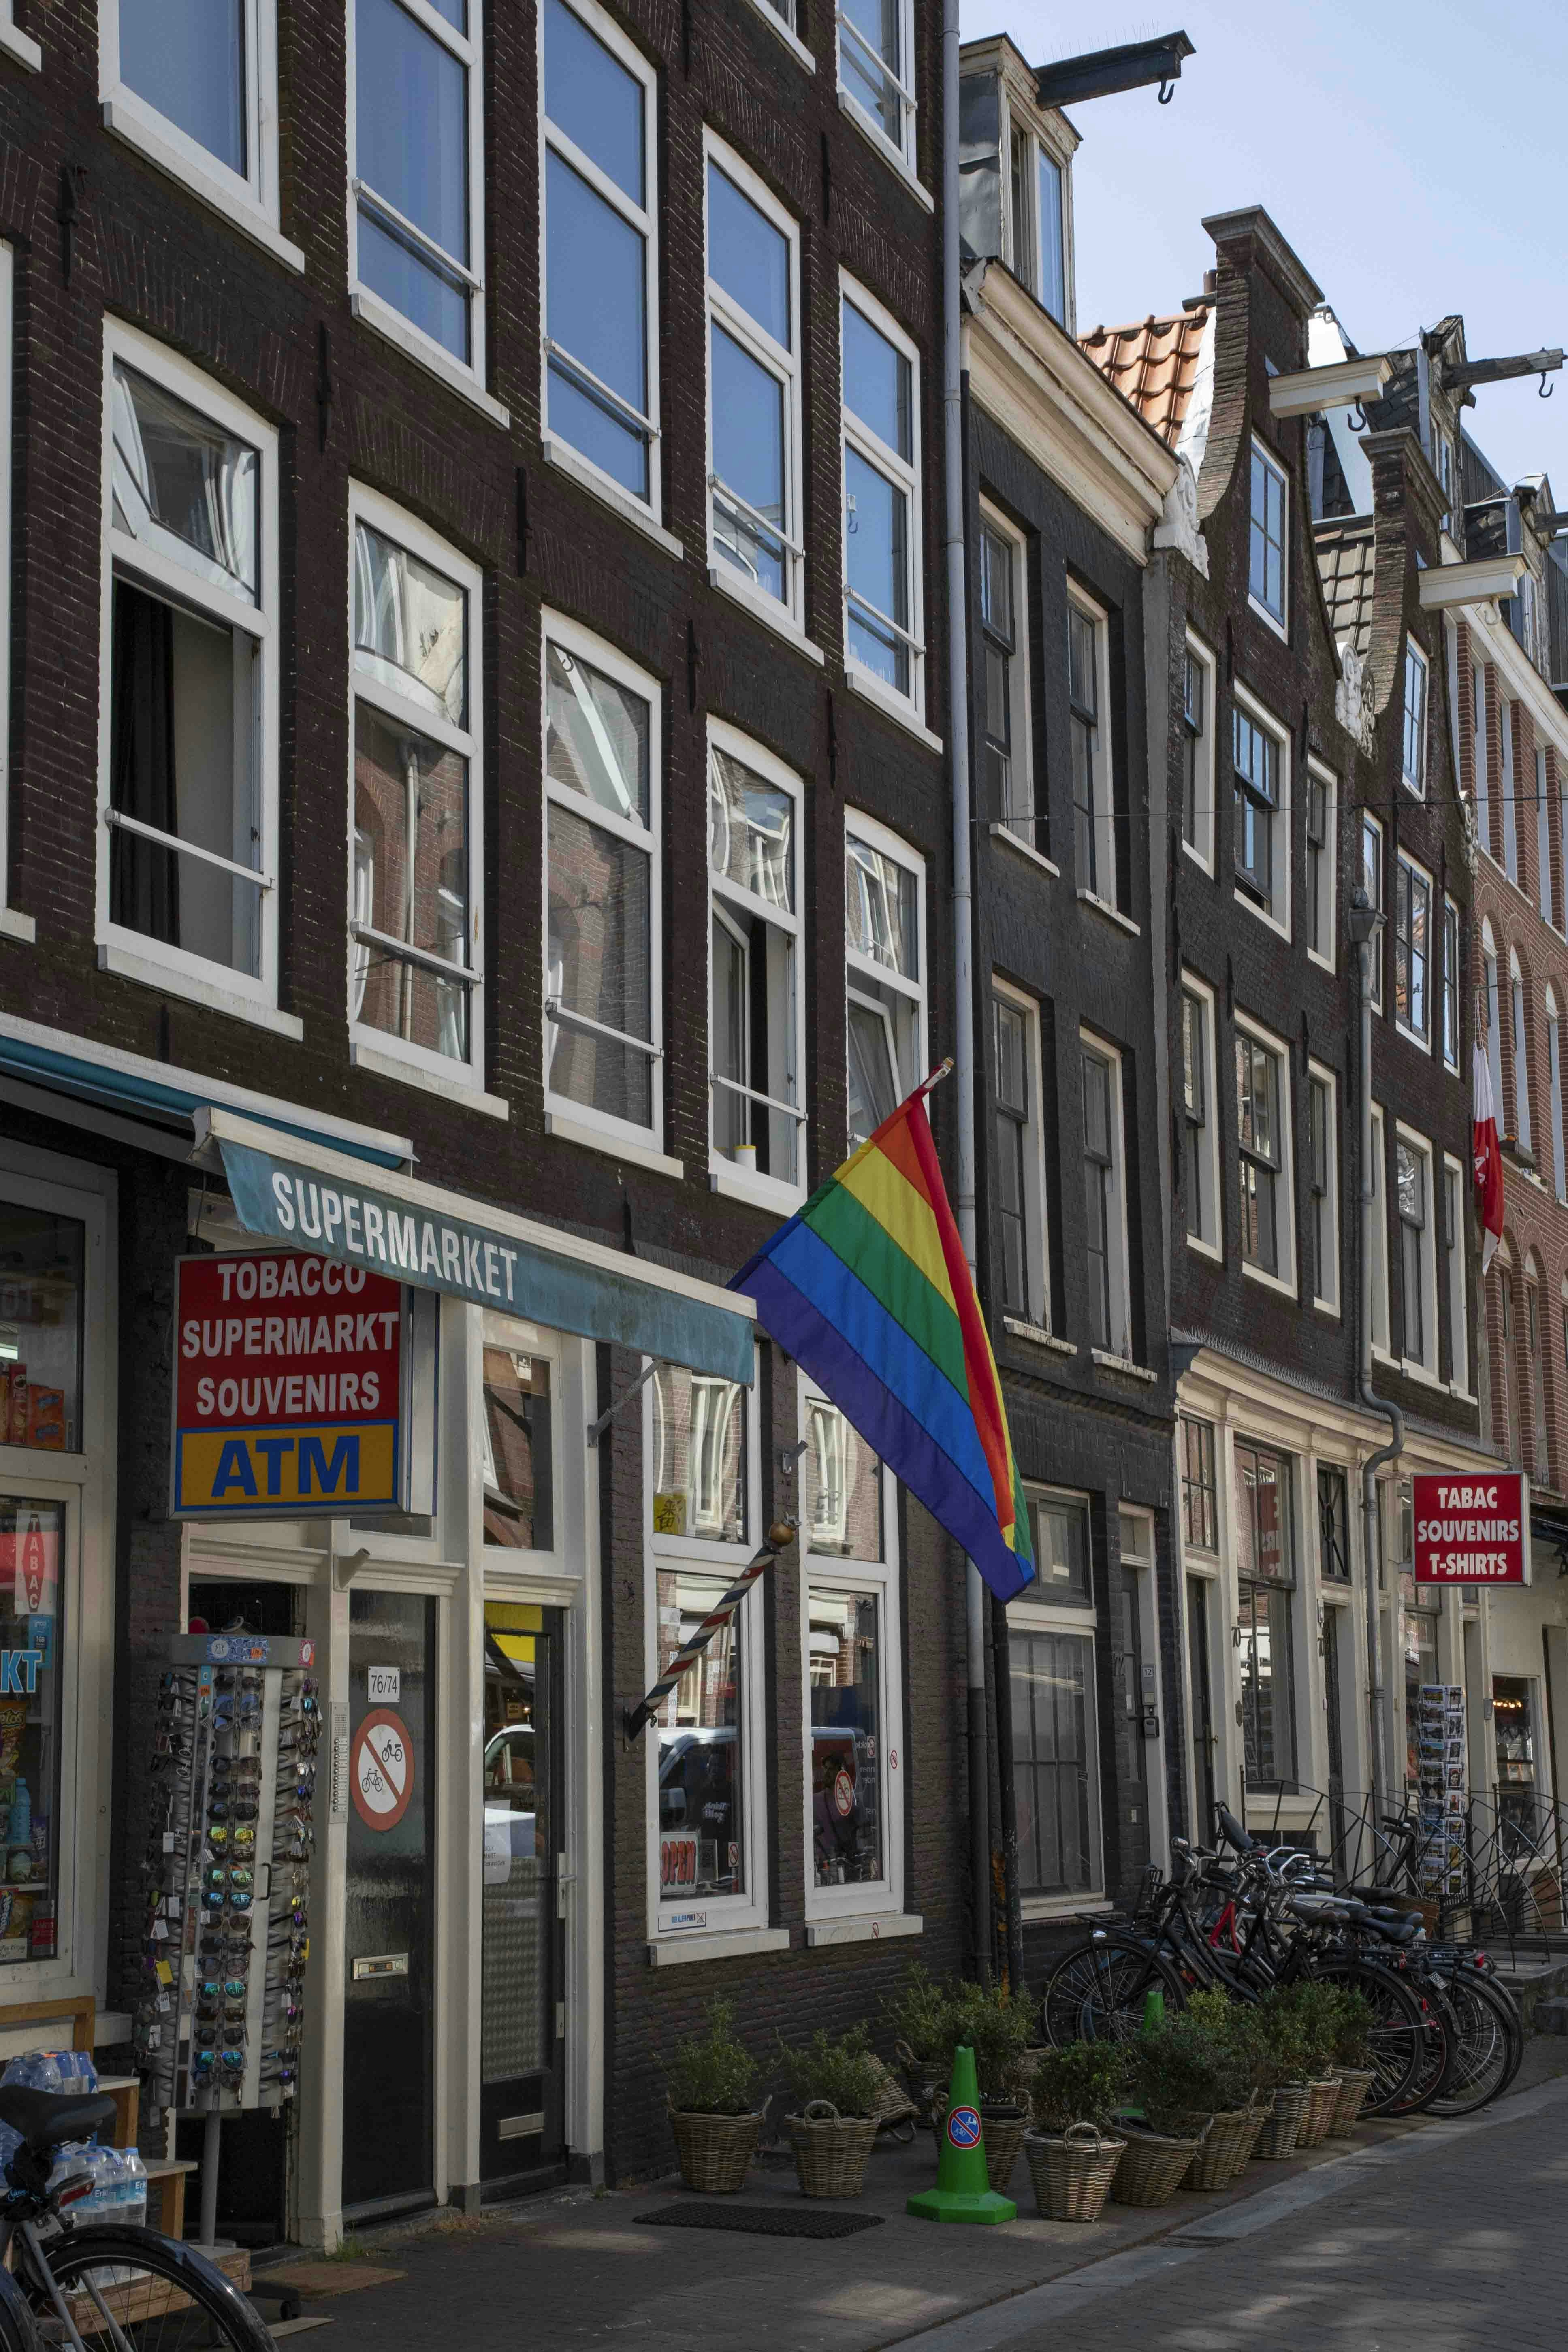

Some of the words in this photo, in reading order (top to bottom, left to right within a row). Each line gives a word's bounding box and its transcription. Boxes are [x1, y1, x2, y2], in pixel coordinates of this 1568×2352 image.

[272, 1172, 517, 1301] SUPERMARKET
[217, 1258, 366, 1301] TOBACCO
[182, 1312, 399, 1358] SUPERMARKT
[196, 1371, 380, 1416] SOUVENIRS
[211, 1435, 360, 1497] ATM
[1438, 1486, 1498, 1509] TABAC
[1417, 1520, 1519, 1542] SOUVENIRS
[28, 1517, 39, 1608] TABAC
[1429, 1553, 1507, 1575] T-SHIRTS
[1231, 1626, 1241, 1647] 70
[371, 1675, 397, 1694] 76/74
[661, 1840, 696, 1886] OPEN
